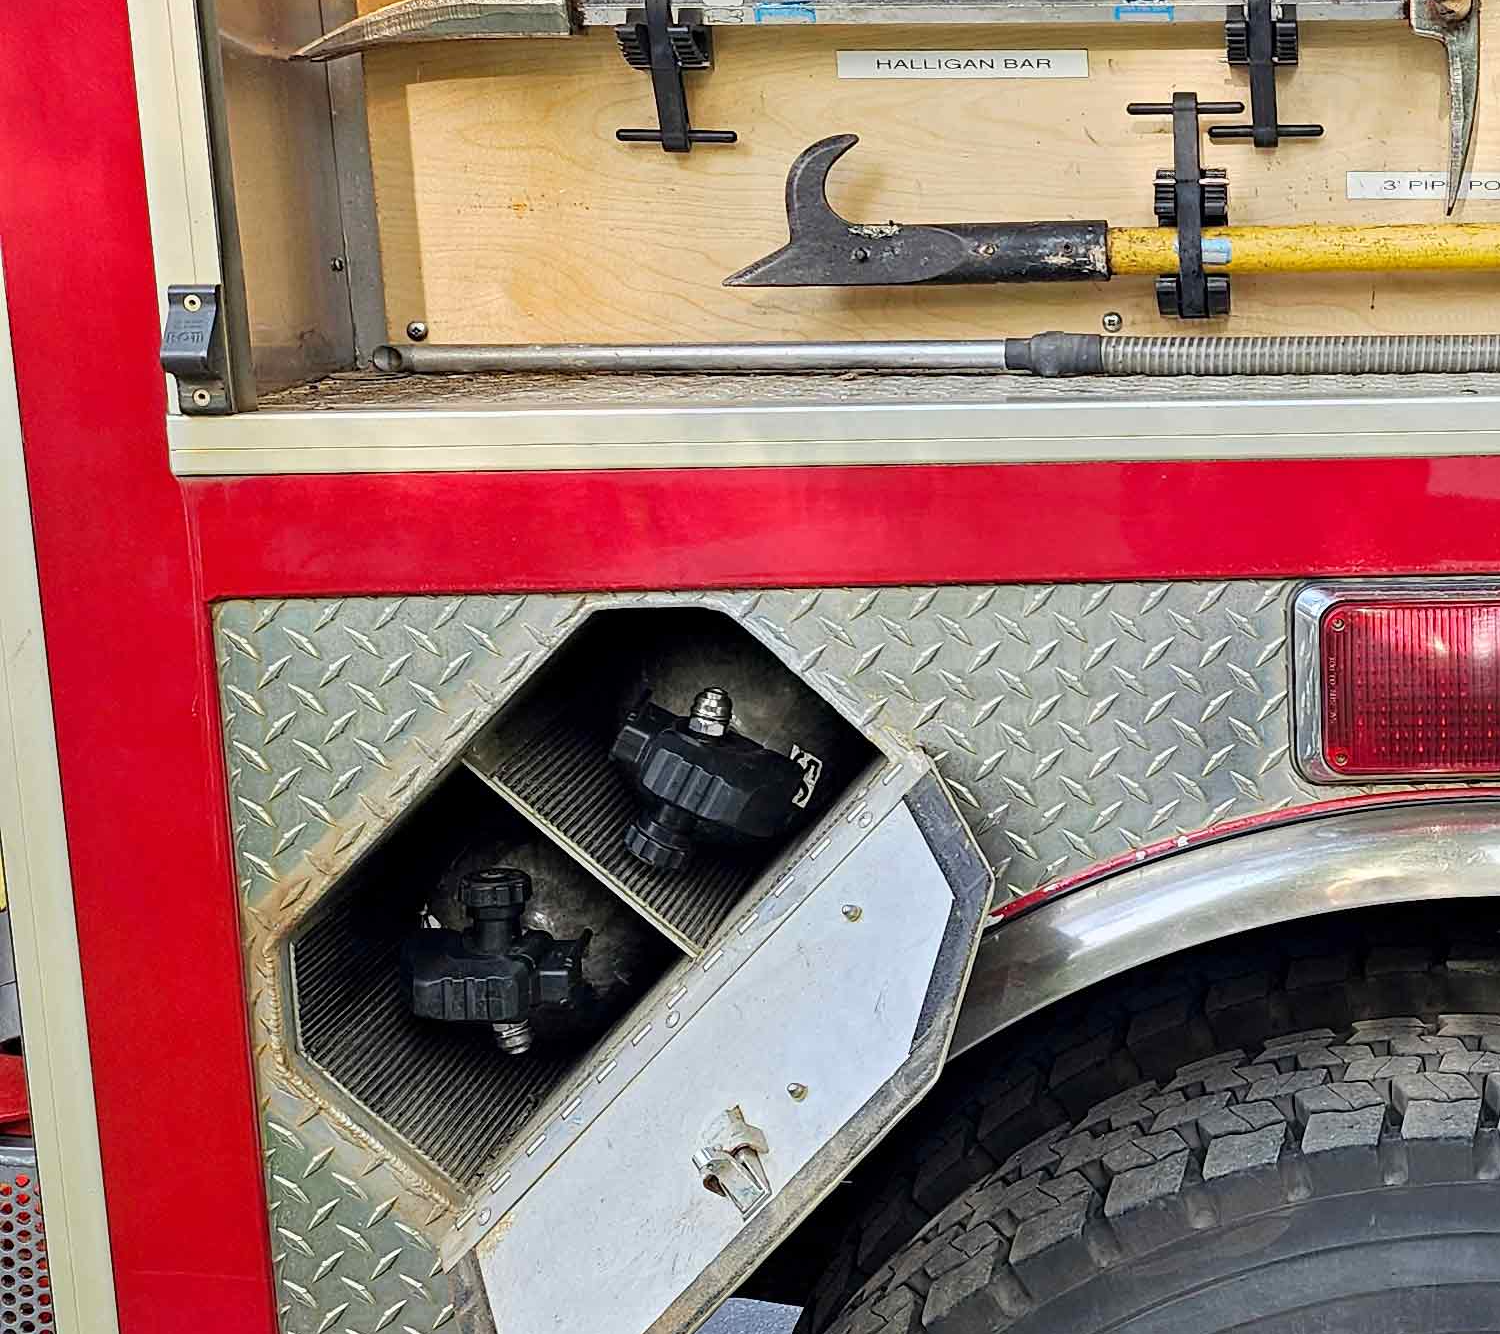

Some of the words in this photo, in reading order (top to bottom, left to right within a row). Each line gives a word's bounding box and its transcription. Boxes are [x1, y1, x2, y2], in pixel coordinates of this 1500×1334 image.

[876, 58, 994, 70] HALLIGAN
[1004, 58, 1052, 69] BAR
[1408, 180, 1453, 191] PIP
